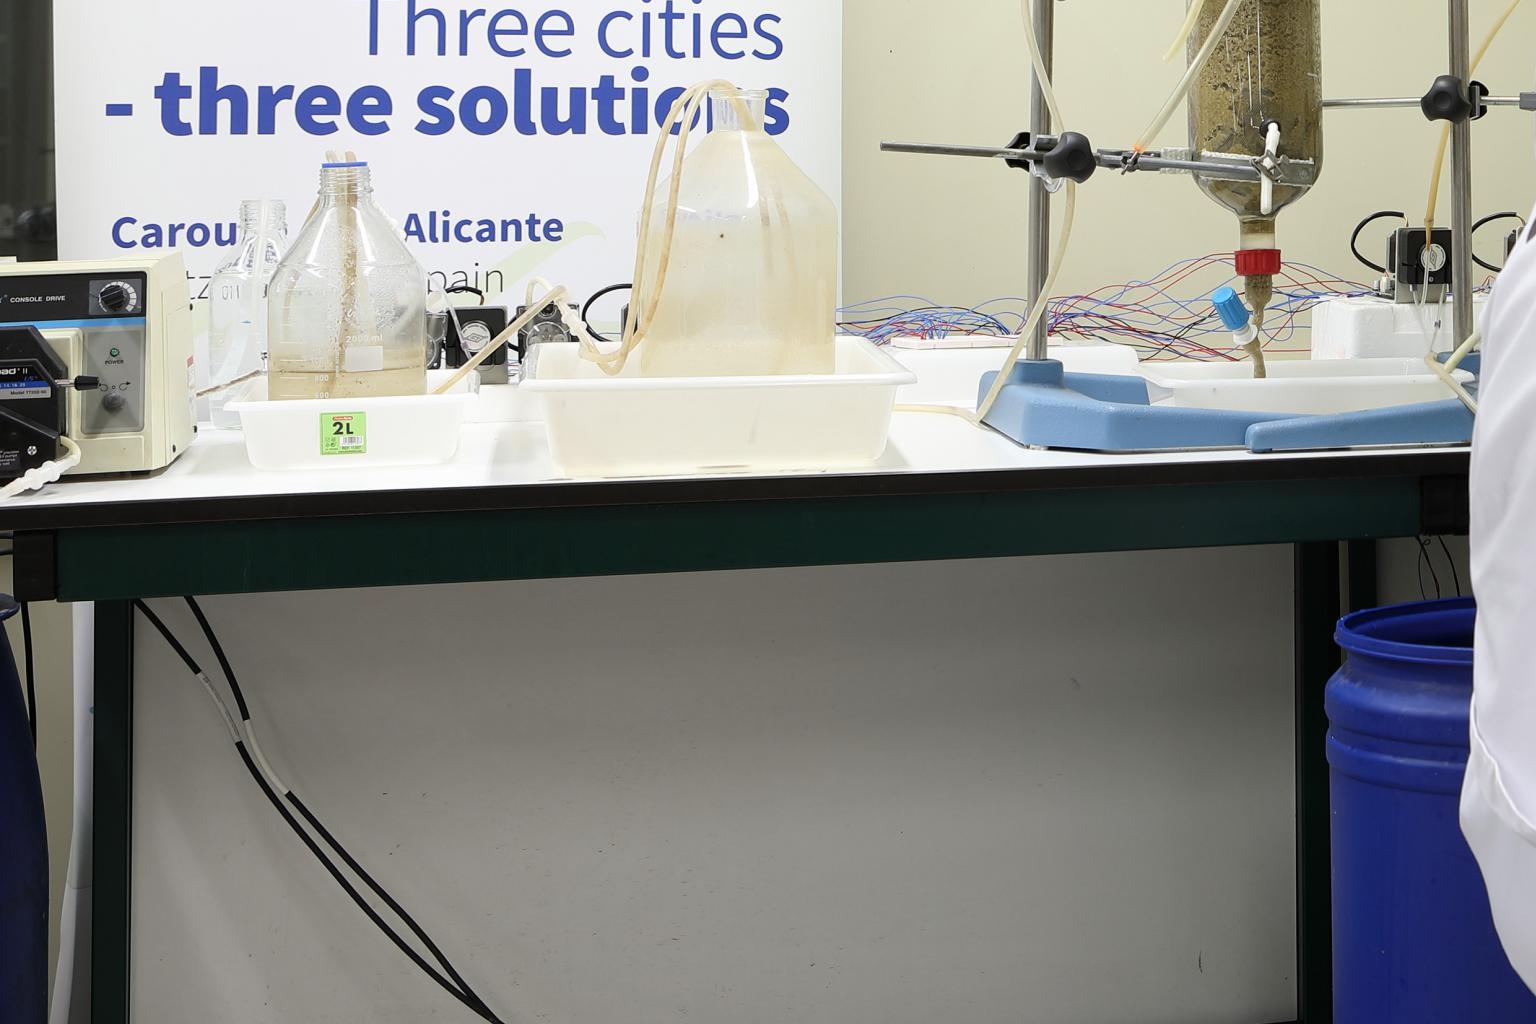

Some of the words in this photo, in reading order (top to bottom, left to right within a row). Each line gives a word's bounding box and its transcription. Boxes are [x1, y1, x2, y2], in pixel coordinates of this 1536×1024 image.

[154, 66, 393, 136] three
[415, 66, 790, 136] solutios
[112, 216, 237, 249] Carou
[404, 210, 564, 243] Alicante
[10, 296, 43, 304] CONSOLE
[45, 295, 66, 303] DRIVE
[332, 421, 354, 435] 2L
